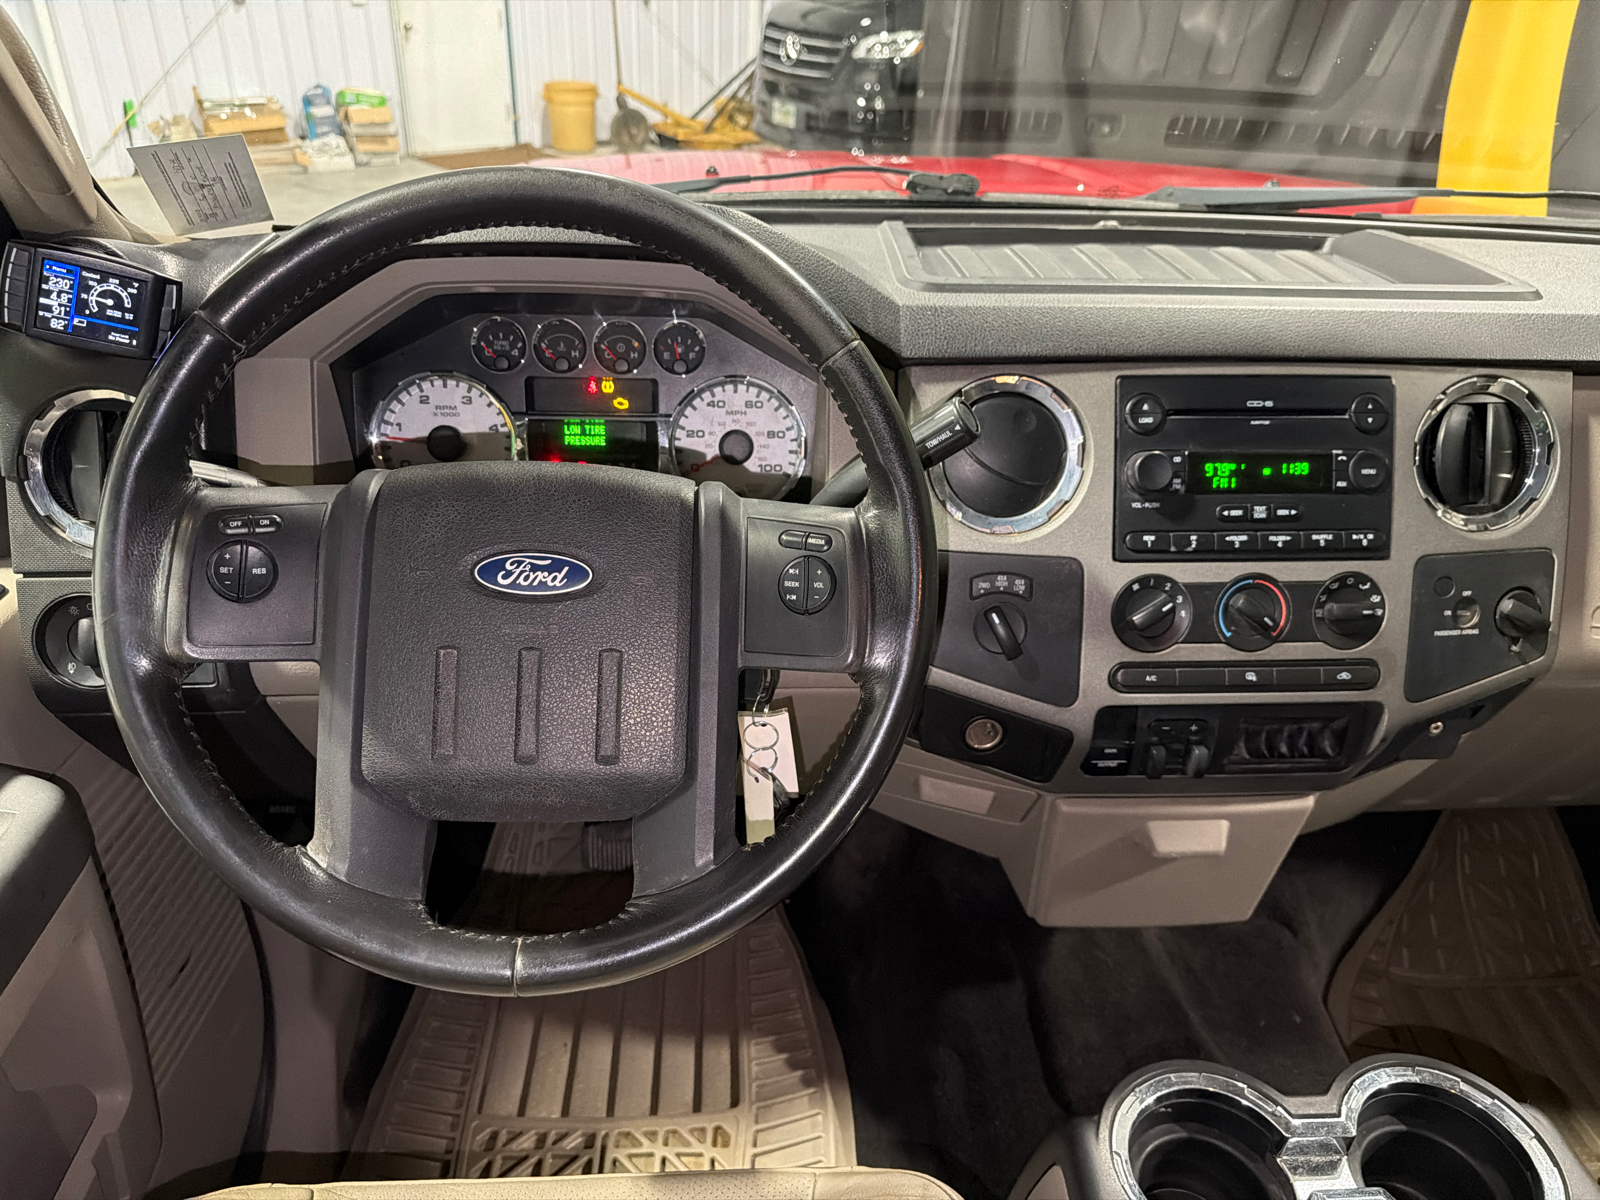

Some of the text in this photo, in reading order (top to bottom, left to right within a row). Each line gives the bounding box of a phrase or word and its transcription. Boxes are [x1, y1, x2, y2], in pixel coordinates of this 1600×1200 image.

[571, 350, 579, 358] H
[630, 351, 639, 359] H
[663, 352, 670, 360] E
[689, 352, 696, 360] F
[419, 395, 430, 405] 2
[461, 395, 473, 405] 3
[706, 400, 726, 409] 40
[744, 400, 764, 409] 60
[1138, 416, 1154, 424] LOAD
[395, 422, 402, 432] 1
[488, 423, 500, 433] 4
[563, 425, 606, 435] LOW TIRE
[685, 429, 705, 439] 20
[766, 430, 786, 439] 80
[564, 436, 607, 446] PRESSURE
[925, 430, 953, 449] TOW/HAUL
[758, 463, 783, 473] 100
[807, 537, 825, 545] MEDIA
[219, 566, 234, 574] SET
[252, 567, 267, 575] RES
[496, 557, 570, 587] Ford
[784, 580, 800, 588] SEEK
[1164, 582, 1172, 591] 2
[1175, 595, 1184, 604] 3
